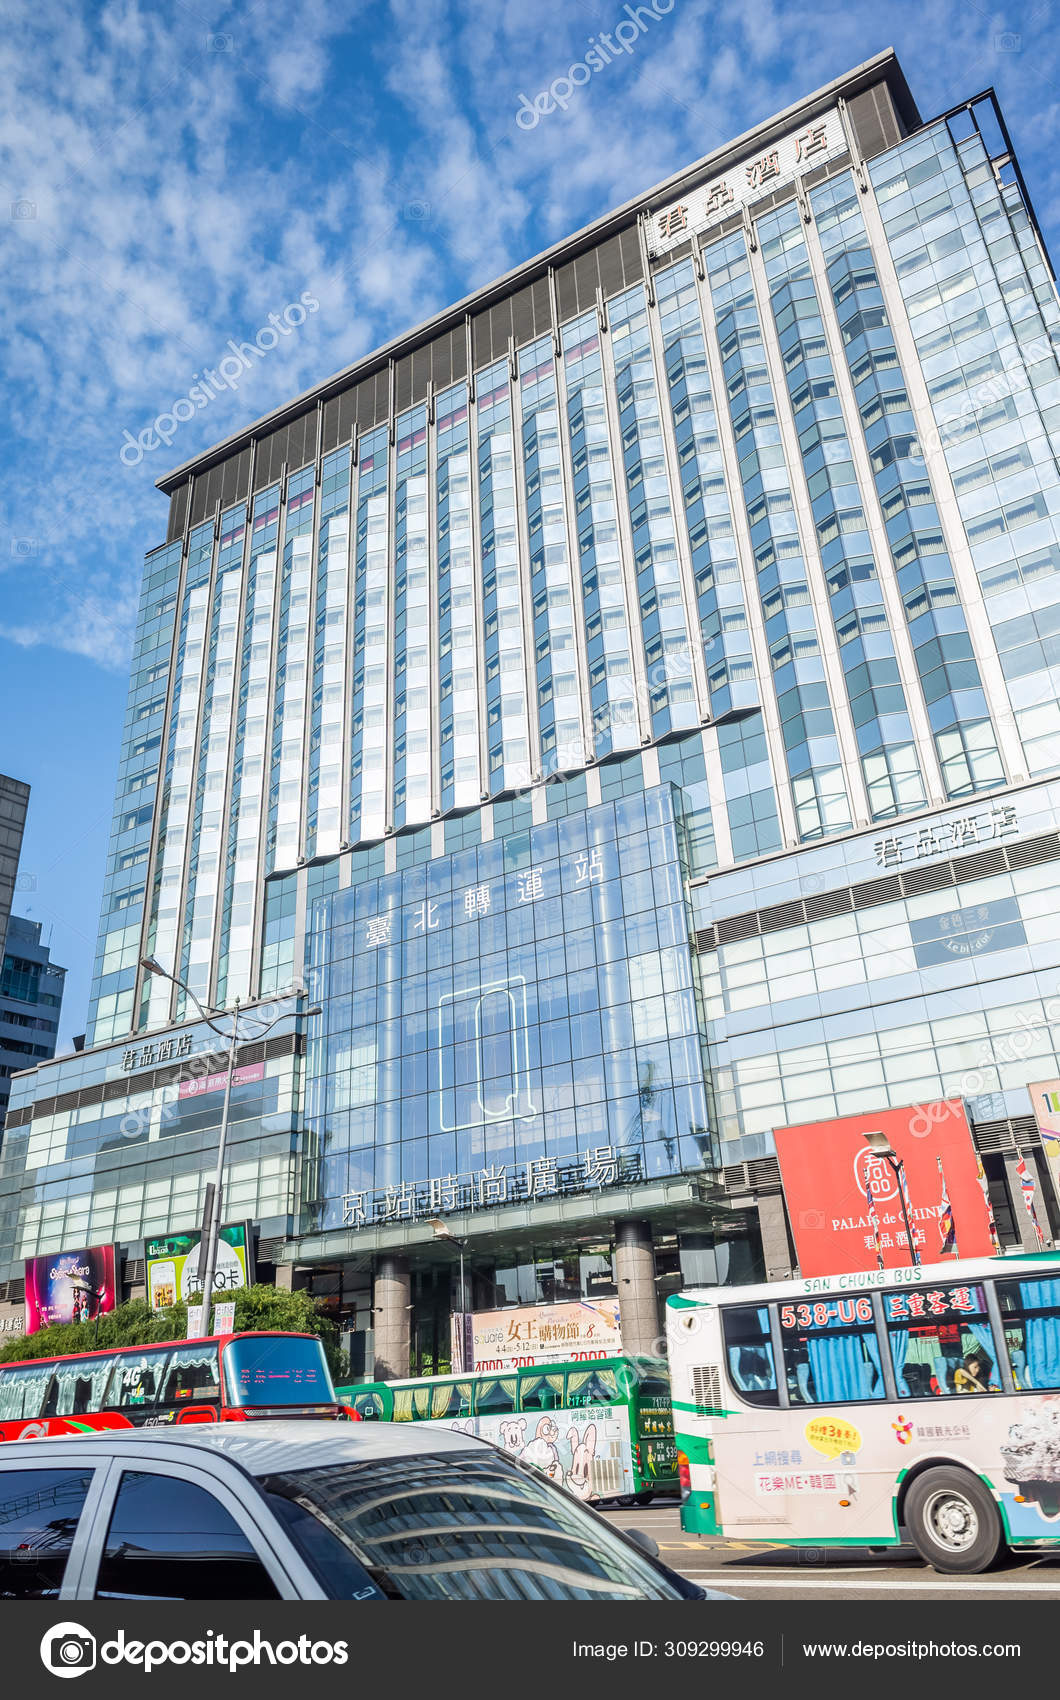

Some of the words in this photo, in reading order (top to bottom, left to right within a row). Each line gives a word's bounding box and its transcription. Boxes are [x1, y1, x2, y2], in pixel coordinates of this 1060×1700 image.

[658, 123, 828, 239] 君品酒店
[874, 806, 1020, 868] 君品酒店
[366, 851, 605, 949] 臺北轉運站
[120, 1034, 193, 1072] 君品酒店
[342, 1146, 619, 1226] 京站時尚廣場
[883, 1212, 897, 1225] de
[804, 1279, 831, 1293] SAN
[839, 1271, 885, 1289] CHUNG
[894, 1266, 922, 1282] BUS
[781, 1297, 872, 1329] 538-U6
[889, 1286, 975, 1318] 三重客運
[122, 1366, 141, 1387] 4G
